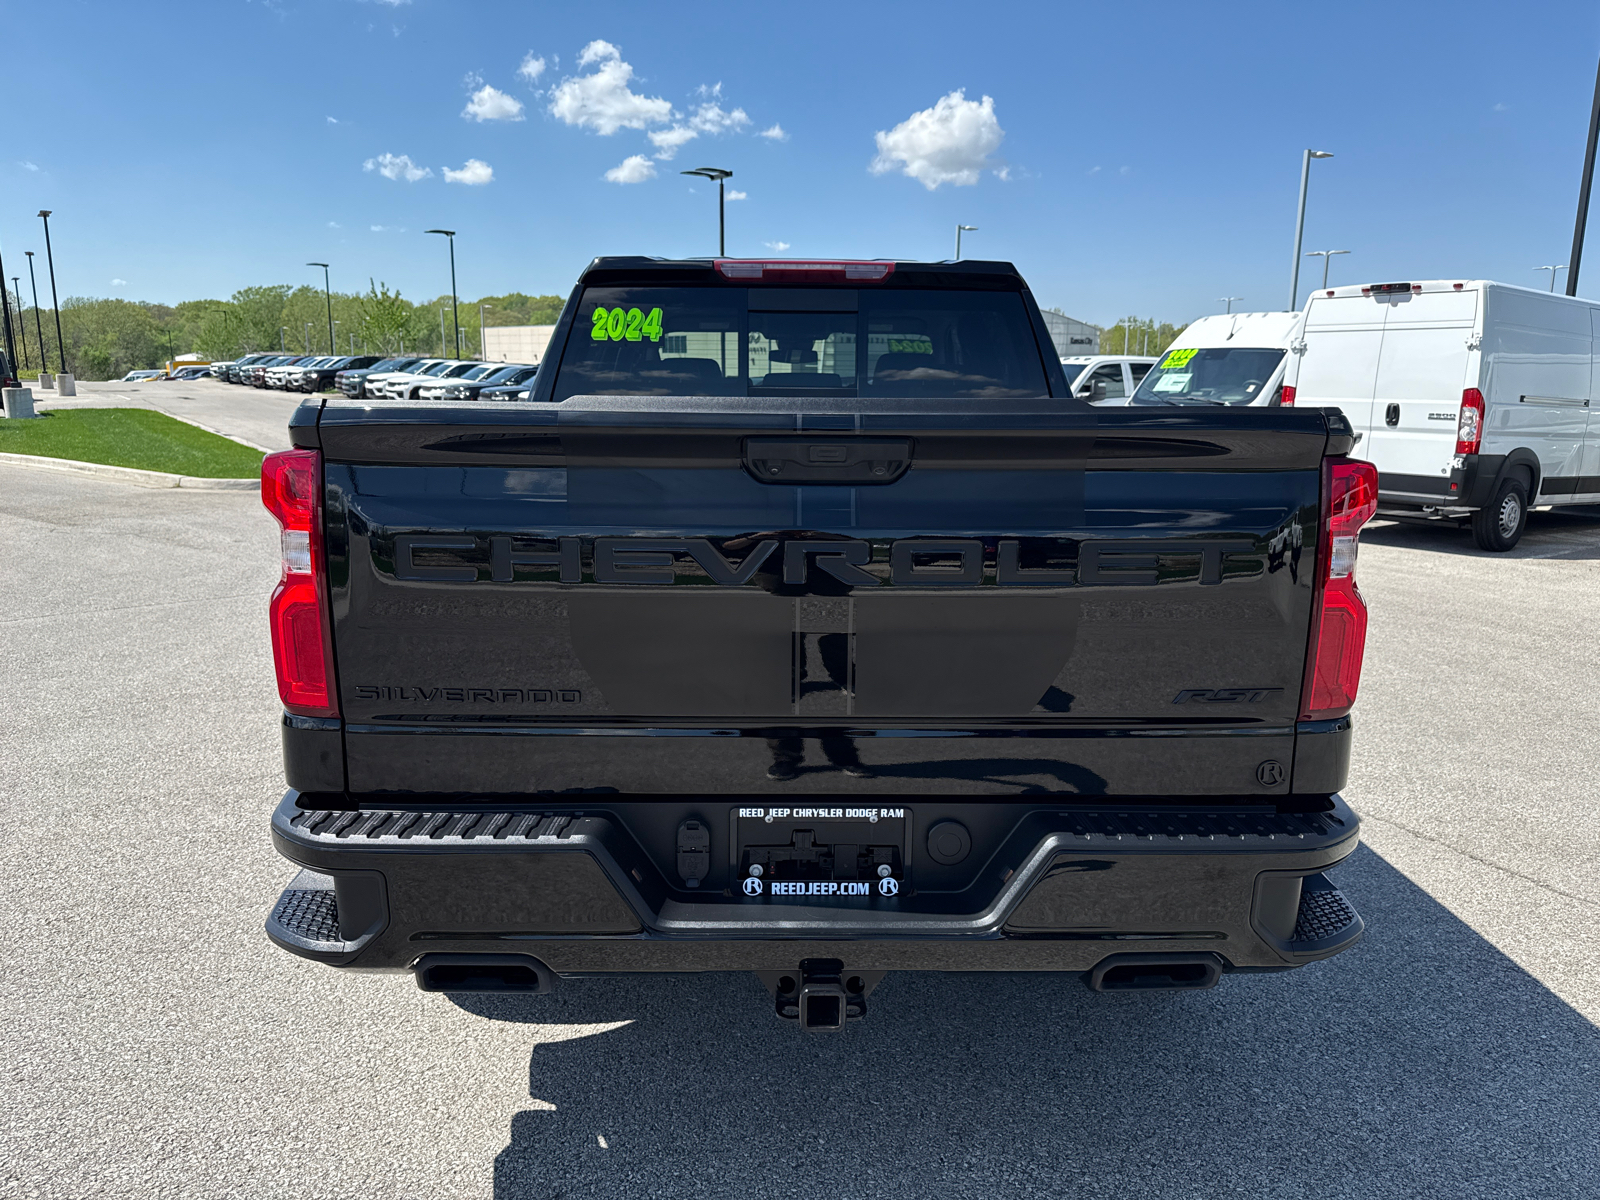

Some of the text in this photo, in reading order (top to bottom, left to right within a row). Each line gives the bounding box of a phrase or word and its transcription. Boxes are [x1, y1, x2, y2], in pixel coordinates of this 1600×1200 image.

[591, 307, 663, 342] 2024
[394, 535, 1257, 585] CHEVROLET
[355, 685, 582, 704] SILVERADO
[1171, 687, 1285, 704] RST
[739, 808, 904, 818] REED JEEP CHRYSLER DODGE RAM
[771, 882, 869, 895] REEDJEEP.COM
